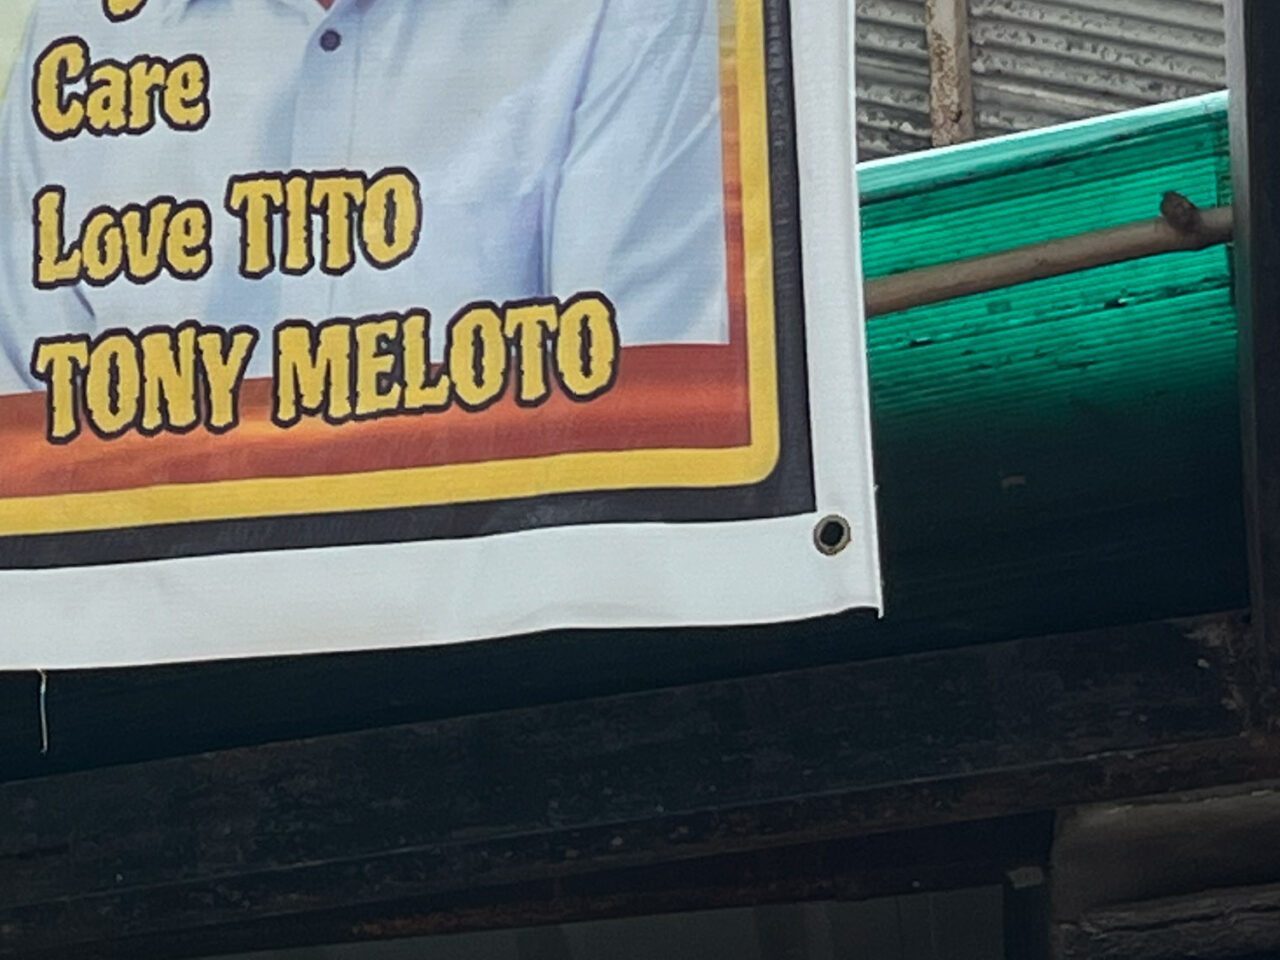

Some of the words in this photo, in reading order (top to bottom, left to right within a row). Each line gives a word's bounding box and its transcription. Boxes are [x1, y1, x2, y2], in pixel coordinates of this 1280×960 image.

[32, 36, 210, 140] Care
[33, 185, 212, 289] Love
[225, 167, 422, 278] TITO
[31, 320, 259, 444] TONY
[272, 291, 619, 427] MELOTO
